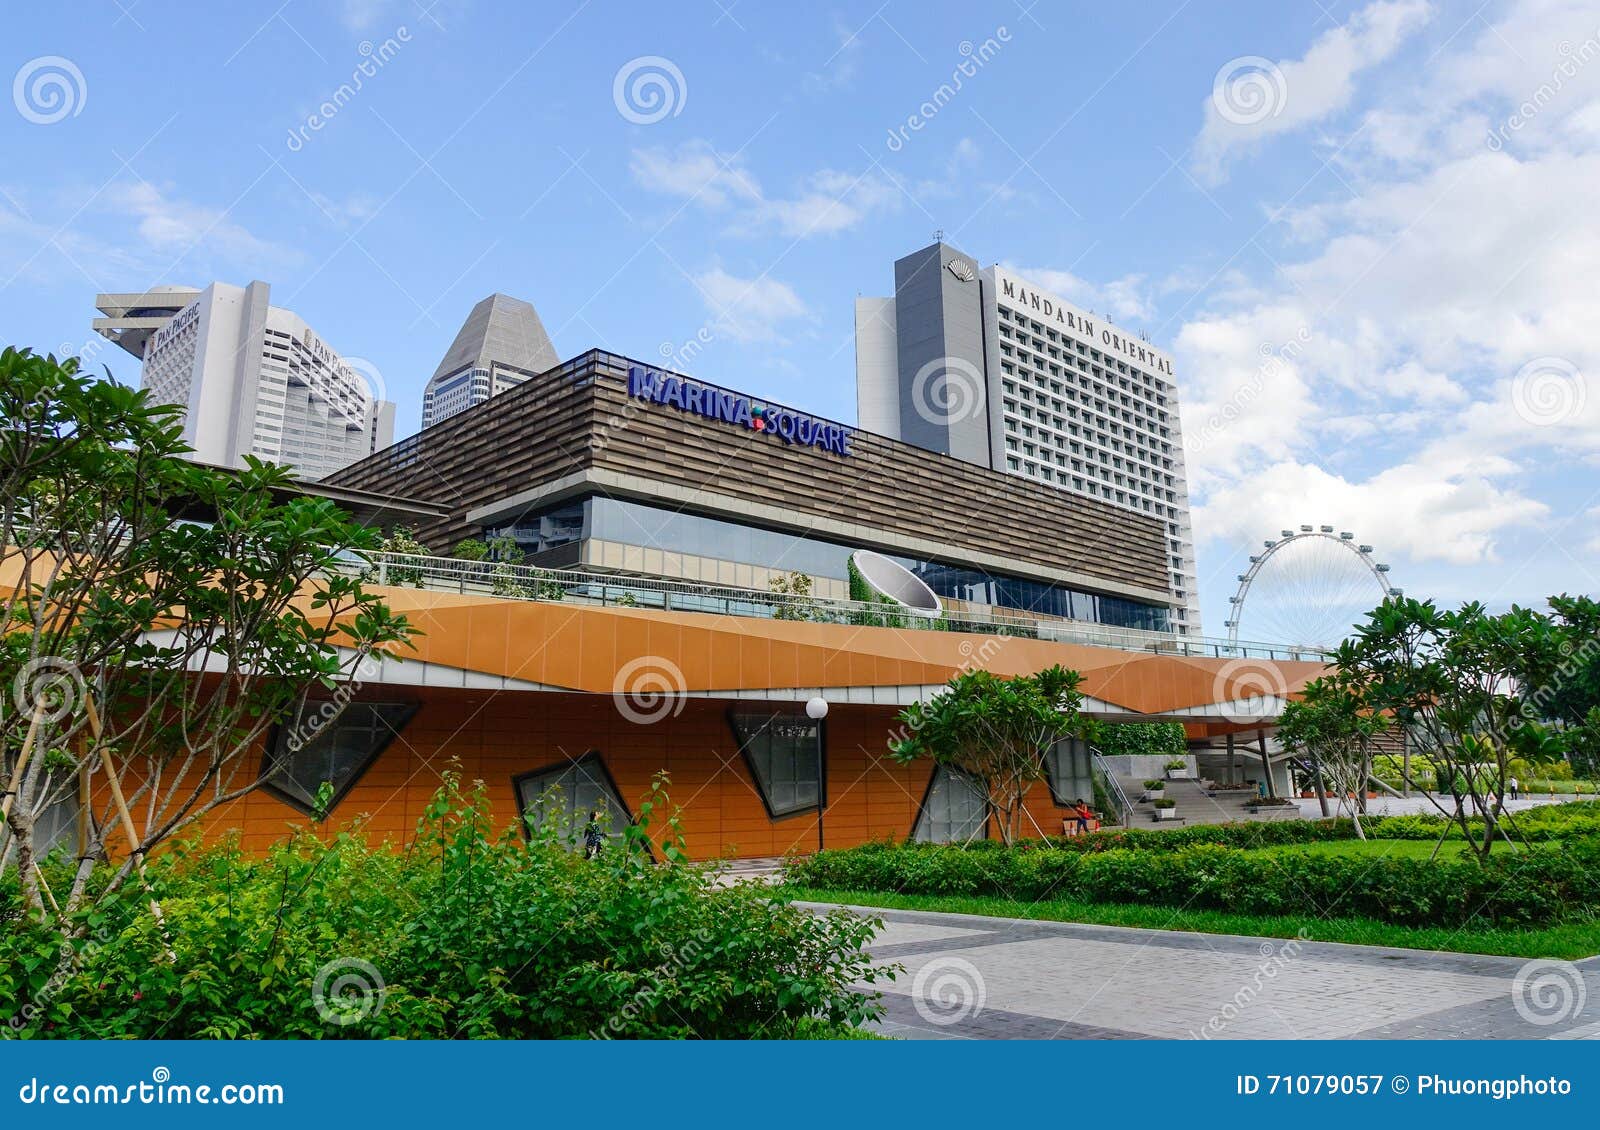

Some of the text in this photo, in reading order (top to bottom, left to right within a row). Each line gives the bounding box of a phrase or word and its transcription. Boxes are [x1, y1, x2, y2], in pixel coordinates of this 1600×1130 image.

[157, 302, 200, 348] PAN PACIFIC
[314, 337, 330, 363] PAN
[1002, 278, 1173, 377] MANDARIN ORIENTAL
[628, 366, 853, 458] MARINA SQUARE
